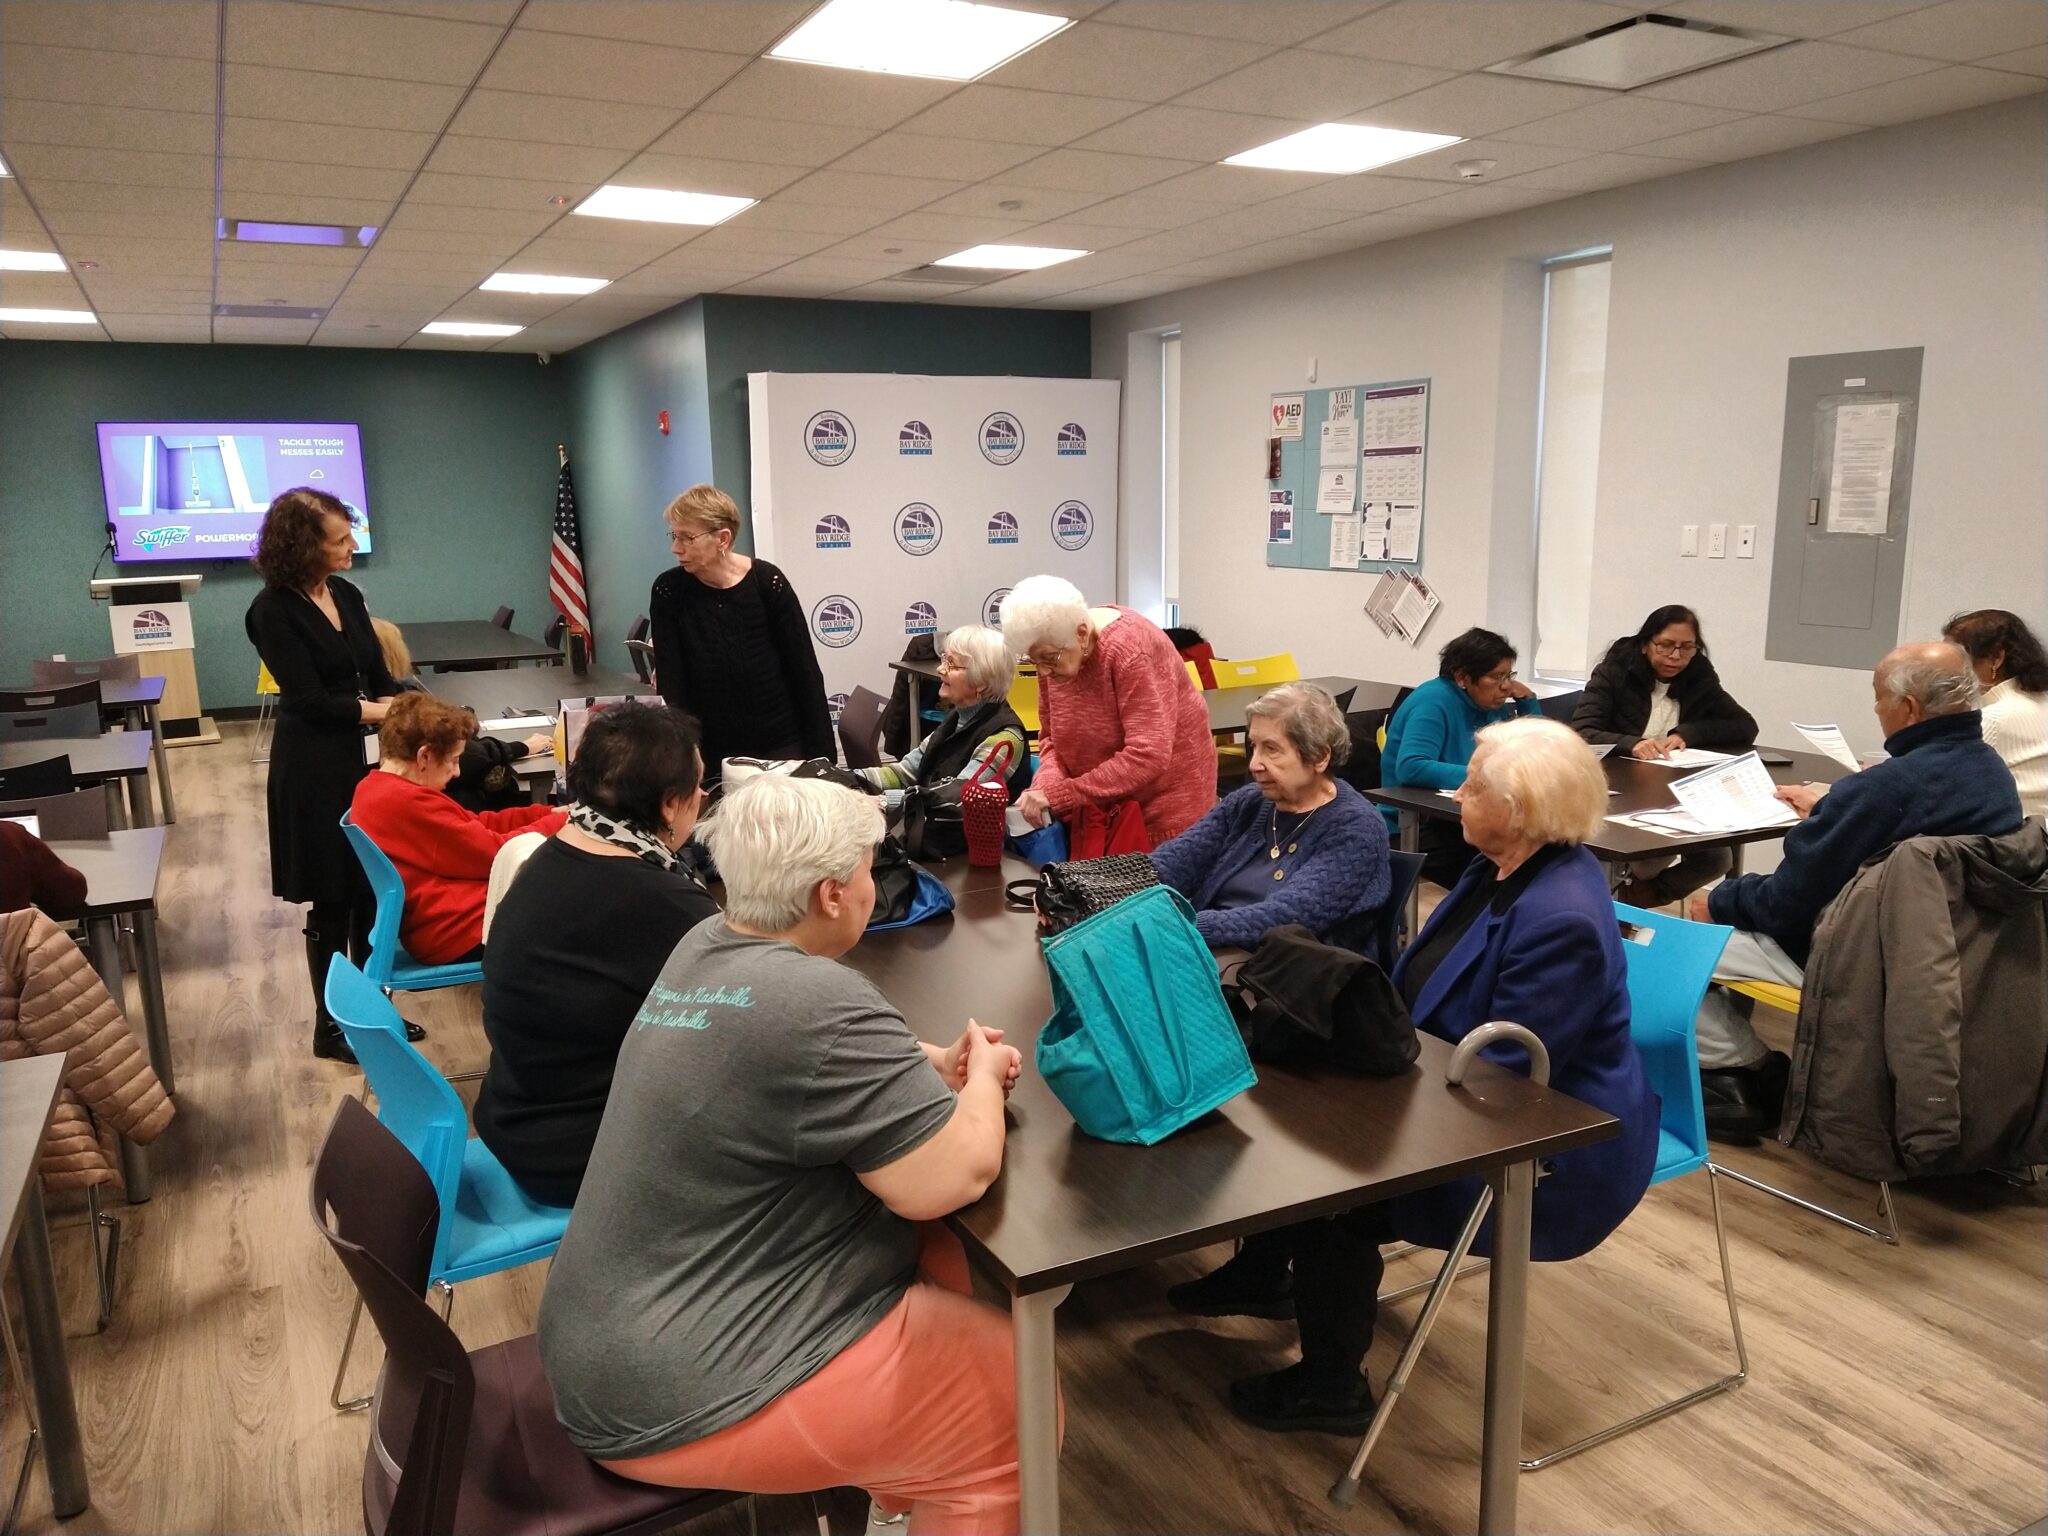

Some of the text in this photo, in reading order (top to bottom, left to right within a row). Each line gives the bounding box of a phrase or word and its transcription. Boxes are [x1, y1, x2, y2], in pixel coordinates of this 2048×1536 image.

[1335, 390, 1352, 404] YAY!
[1285, 404, 1302, 417] AED
[278, 438, 344, 446] TACKLE TOUGH
[815, 437, 846, 445] BAY RIDGE
[899, 440, 933, 449] BAY RIDGE
[998, 437, 1015, 445] RIDGE
[1057, 441, 1087, 449] BAY RIDGE
[280, 448, 344, 456] MESSES EASILY
[915, 527, 932, 535] RIDGE
[988, 529, 1019, 538] BAY RIDGE
[133, 529, 188, 547] Swiffer
[815, 533, 851, 542] BAY RIDGE
[905, 619, 938, 628] BAY RIDGE
[691, 985, 757, 1008] Nashville
[658, 1008, 712, 1030] Nashville
